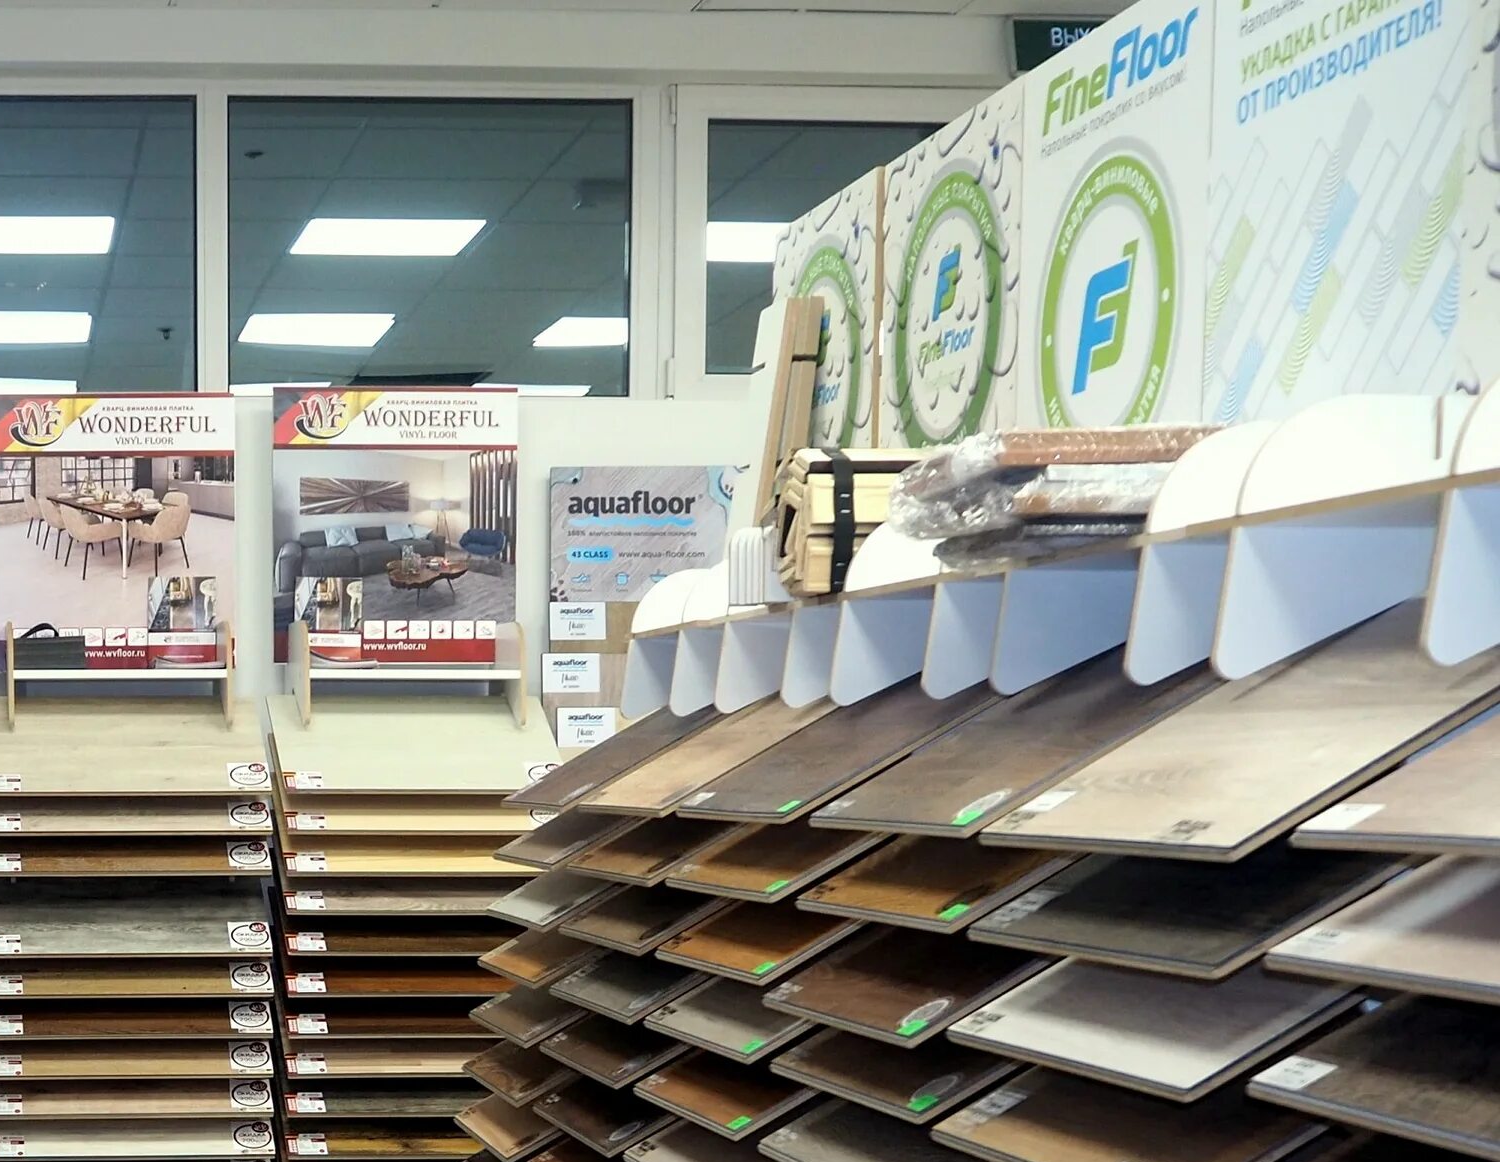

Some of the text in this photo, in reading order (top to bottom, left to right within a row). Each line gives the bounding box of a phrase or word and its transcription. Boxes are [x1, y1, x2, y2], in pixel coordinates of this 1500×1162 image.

[1051, 27, 1094, 47] ВЫХ
[1240, 26, 1317, 83] УКЛАДКА
[1236, 0, 1445, 126] ОТ ПРОИЗВОДИТЕЛЯ!
[364, 407, 499, 427] WONDERFUL
[79, 413, 216, 433] WONDERFUL
[399, 430, 457, 439] VINYL FLOOR
[115, 436, 174, 445] VINYL FLOOR
[568, 491, 696, 517] aquafloor
[619, 550, 706, 559] www.aqua-floor.com
[560, 607, 595, 615] aquafloor
[363, 642, 426, 651] www.wvfloor.ru
[552, 659, 588, 667] aquafloor
[568, 714, 604, 722] aquafloor
